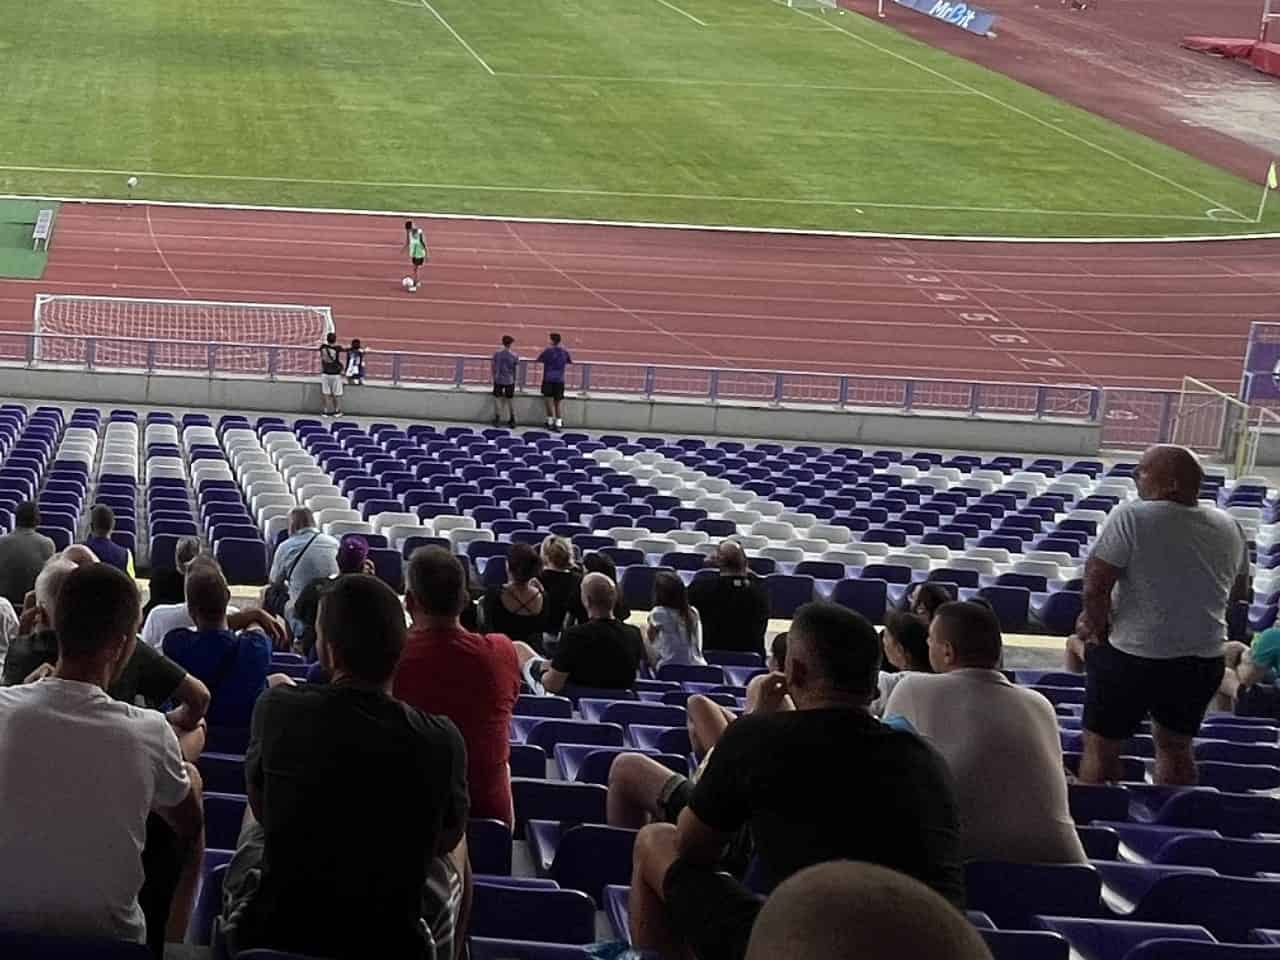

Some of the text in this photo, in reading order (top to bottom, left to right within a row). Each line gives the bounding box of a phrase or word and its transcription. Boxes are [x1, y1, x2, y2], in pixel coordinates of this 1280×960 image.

[960, 313, 1000, 322] 5
[990, 334, 1029, 344] 6
[1021, 358, 1064, 368] 7
